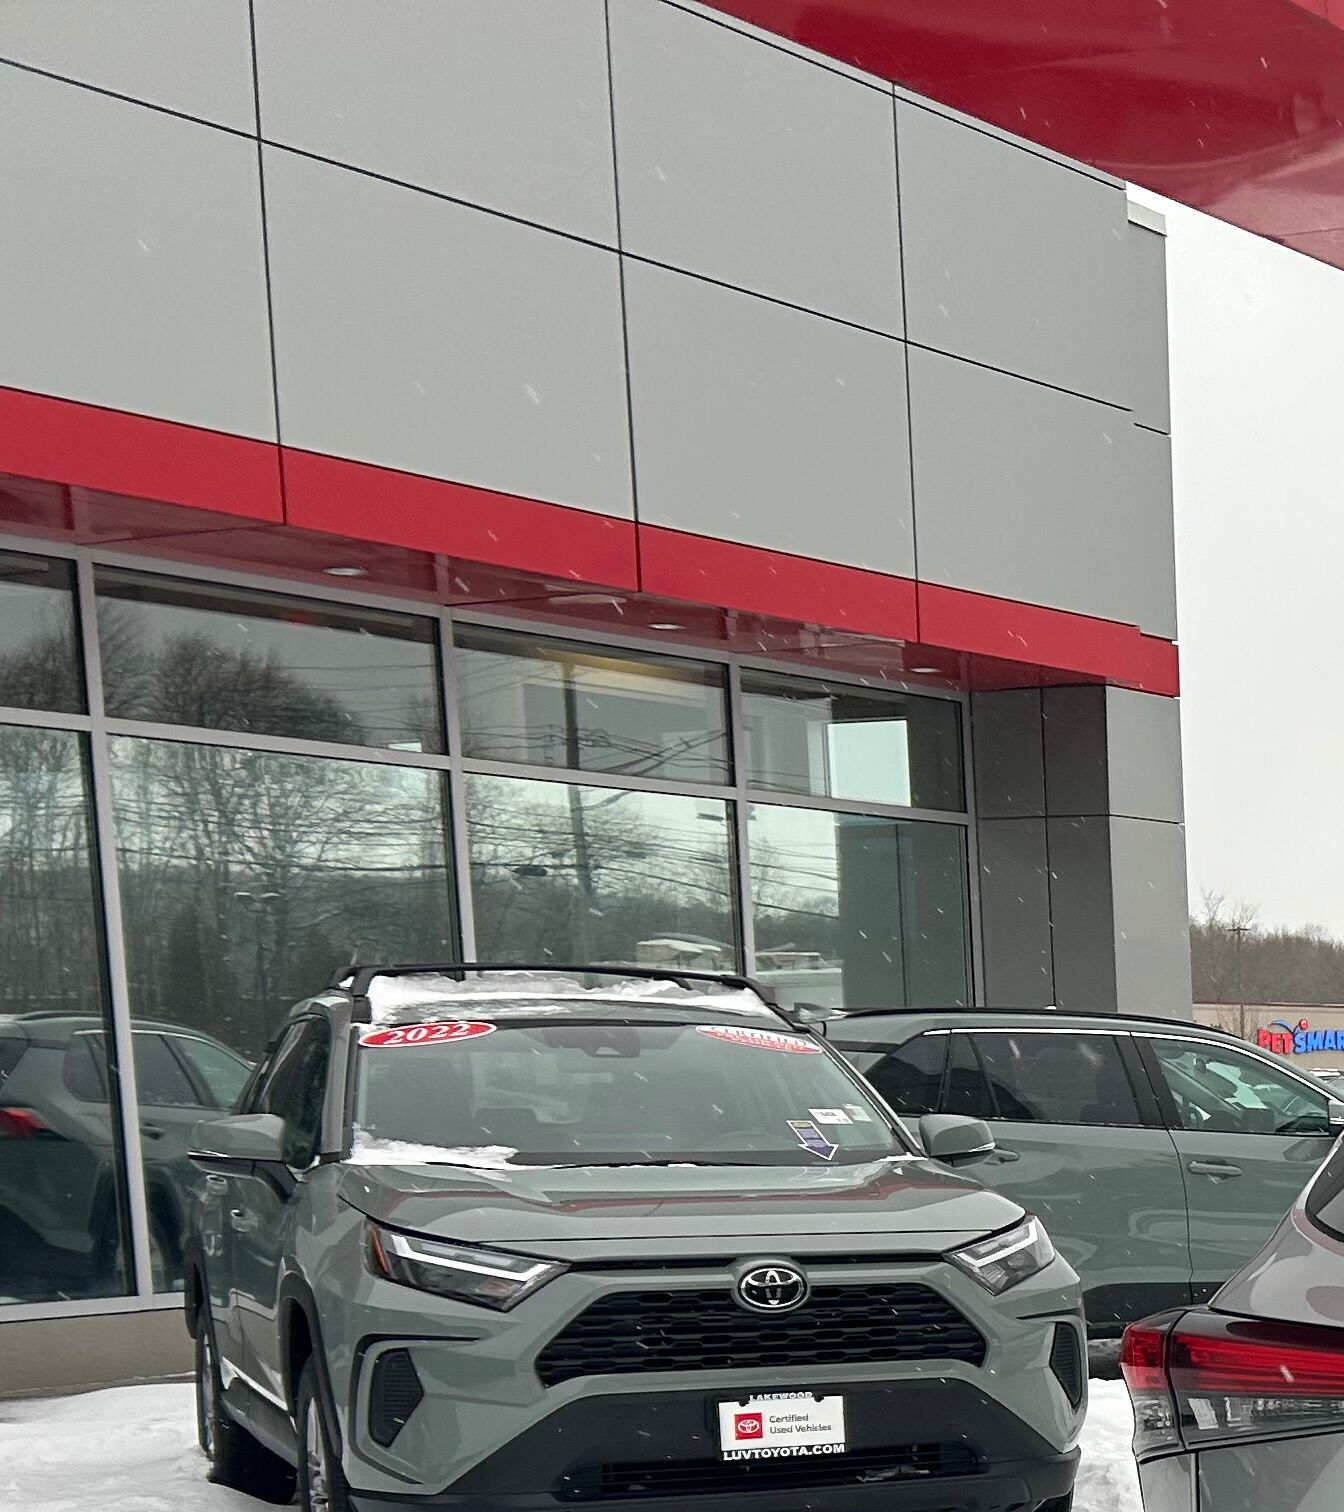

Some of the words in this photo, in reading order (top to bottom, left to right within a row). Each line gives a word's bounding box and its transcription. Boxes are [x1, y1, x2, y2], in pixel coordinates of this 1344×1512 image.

[384, 1023, 471, 1045] 2022
[749, 1391, 813, 1401] LAKEWOOD
[769, 1413, 809, 1423] Certified
[769, 1426, 793, 1434] Used
[794, 1424, 832, 1433] Vehicles
[723, 1444, 845, 1461] LUVTOYOTA.COM
